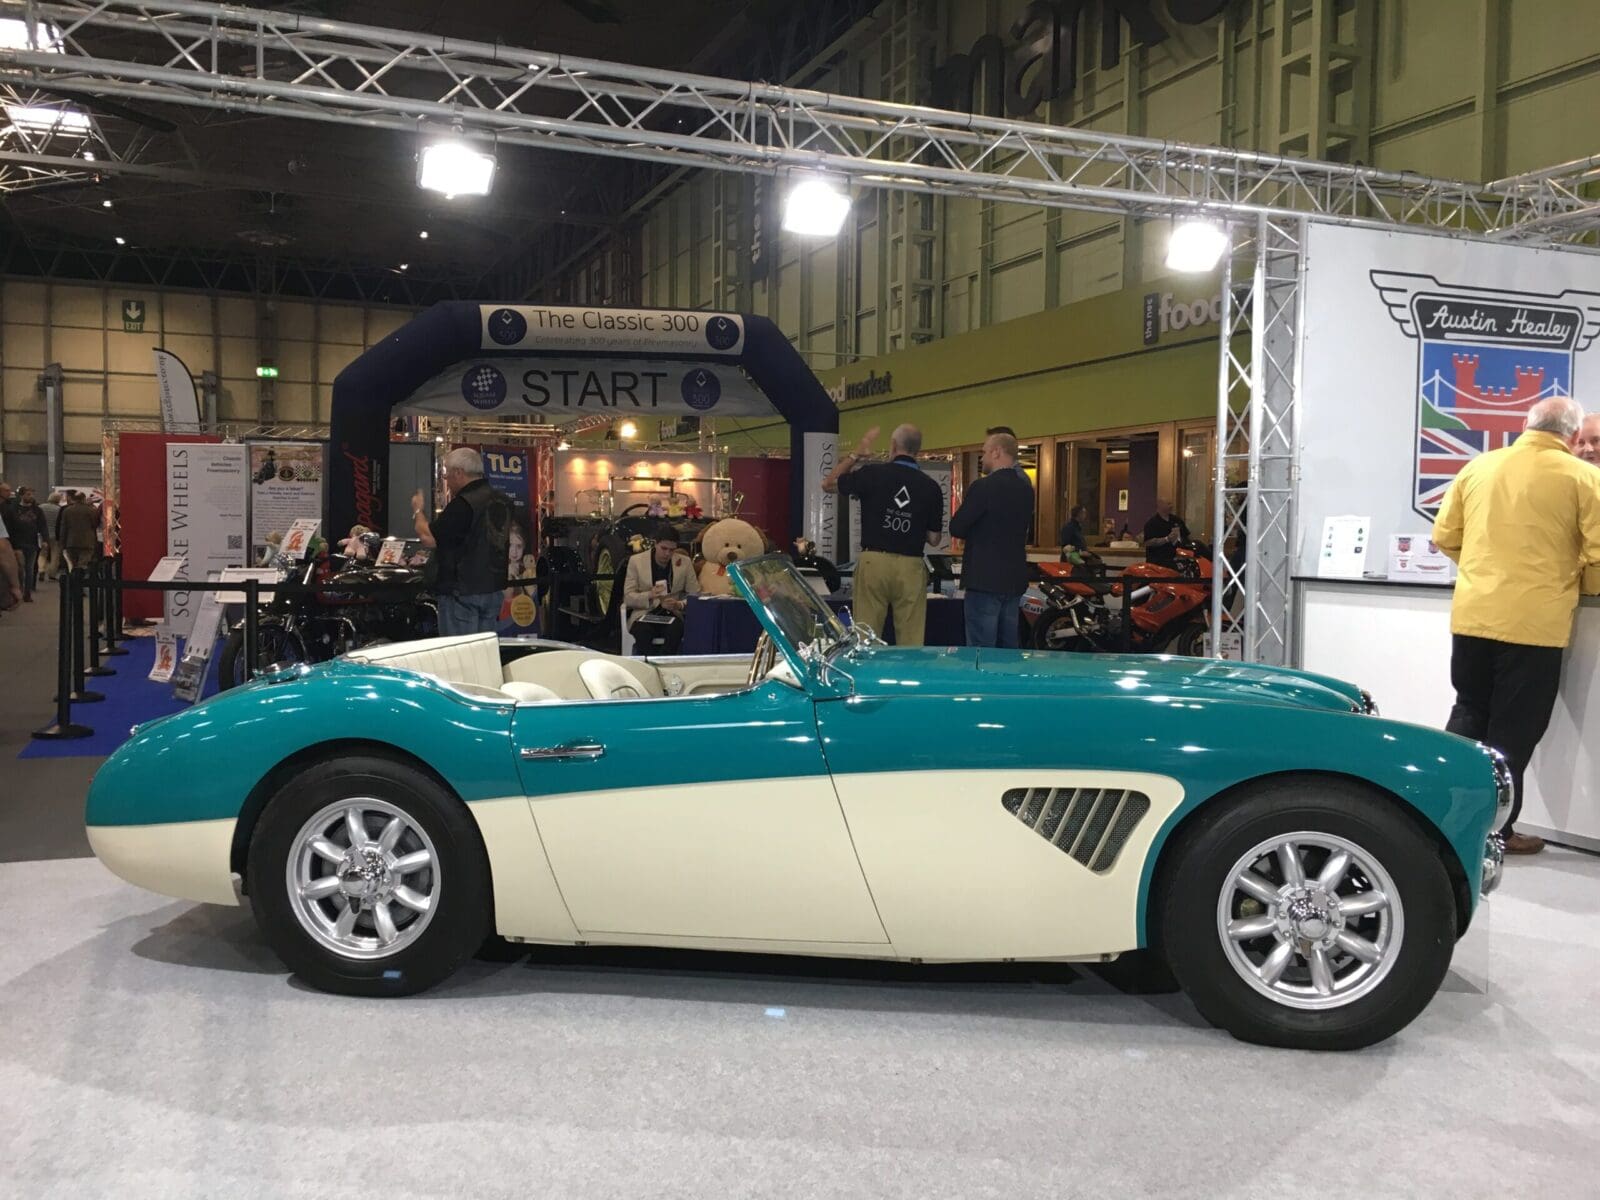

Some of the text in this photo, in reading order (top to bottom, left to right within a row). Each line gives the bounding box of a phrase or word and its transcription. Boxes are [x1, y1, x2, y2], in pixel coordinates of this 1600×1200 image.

[533, 310, 699, 333] The Classic 300
[1425, 304, 1571, 338] Austin Healey
[535, 335, 586, 346] Celebrating
[589, 336, 606, 346] 300
[632, 337, 642, 346] of
[522, 369, 668, 407] START
[486, 453, 522, 474] TLC
[820, 441, 833, 509] SQURE
[171, 449, 189, 531] WHEELS
[882, 514, 911, 533] 300
